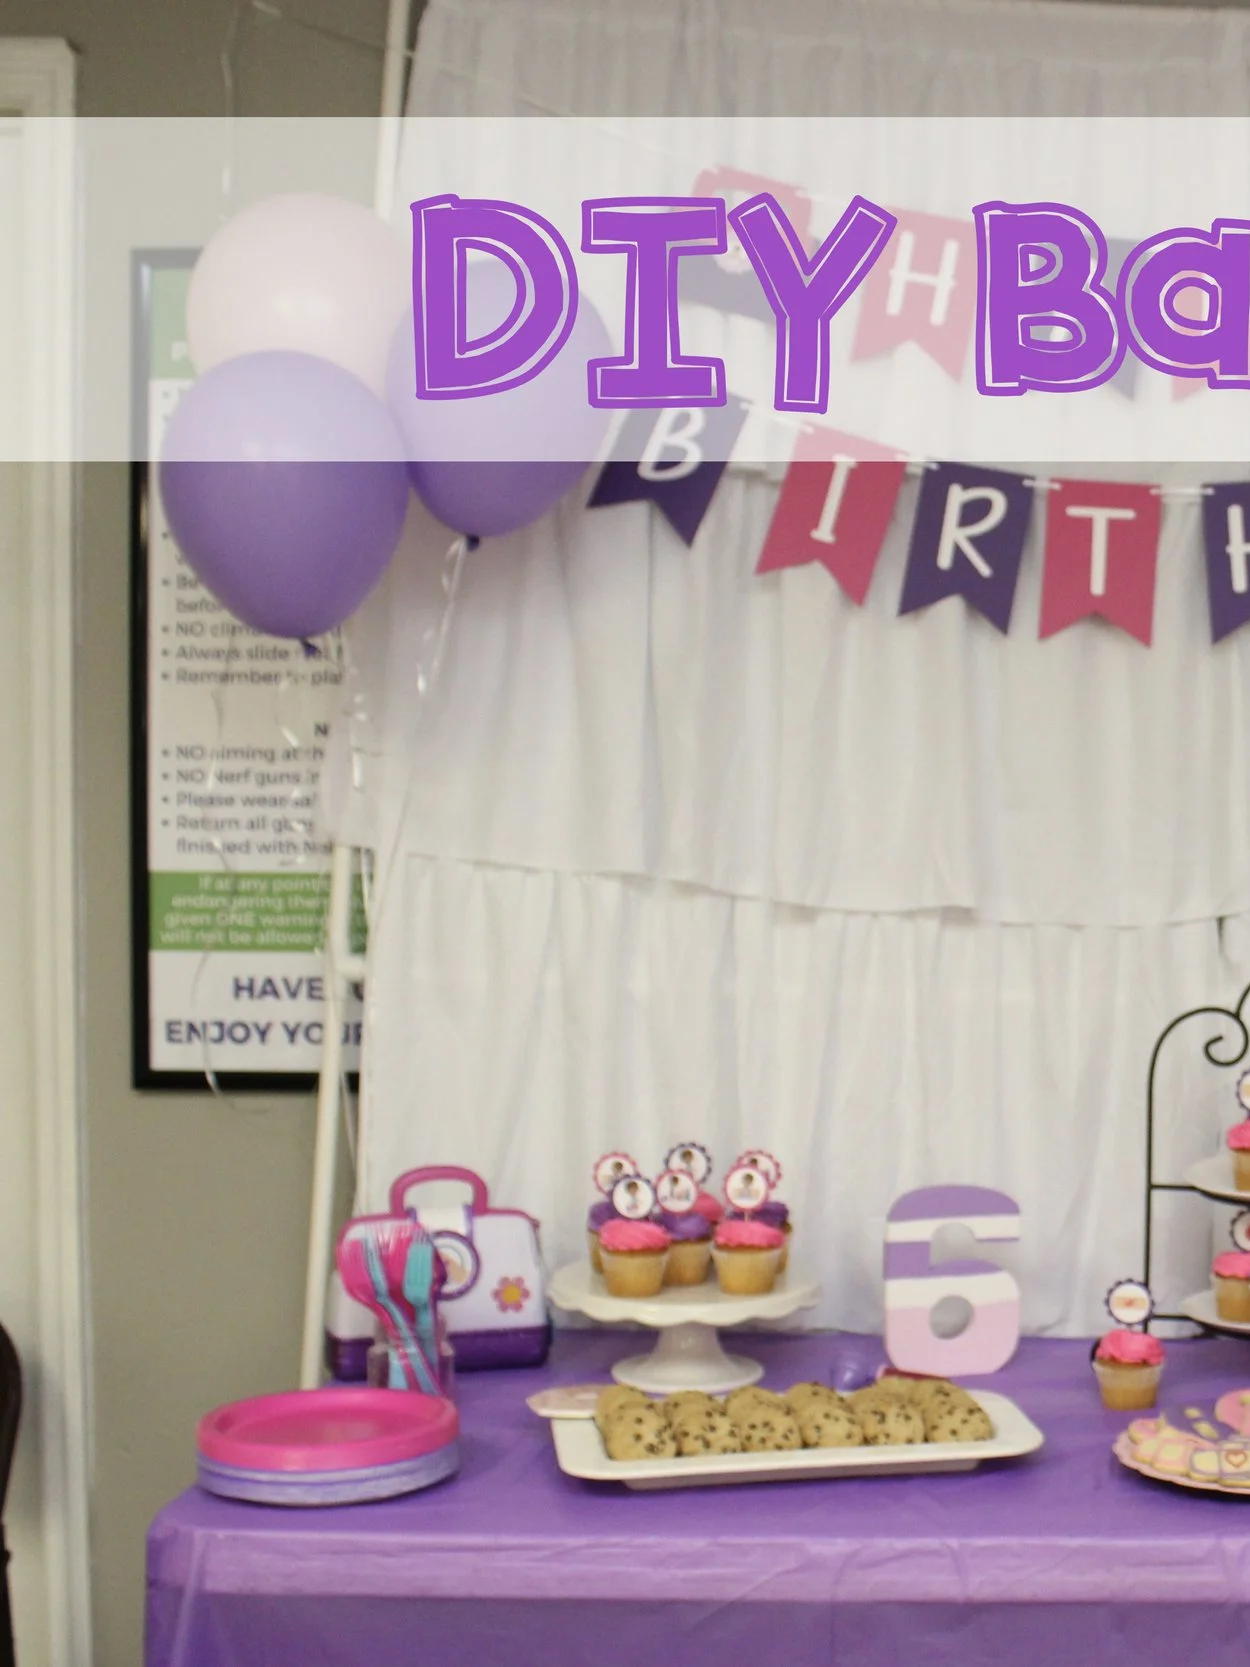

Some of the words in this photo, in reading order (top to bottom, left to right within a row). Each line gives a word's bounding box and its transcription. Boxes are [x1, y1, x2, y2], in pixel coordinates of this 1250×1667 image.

[176, 596, 221, 614] befo
[233, 976, 325, 1000] HAVE
[165, 1021, 273, 1044] ENJOY
[883, 1184, 1021, 1377] 6
